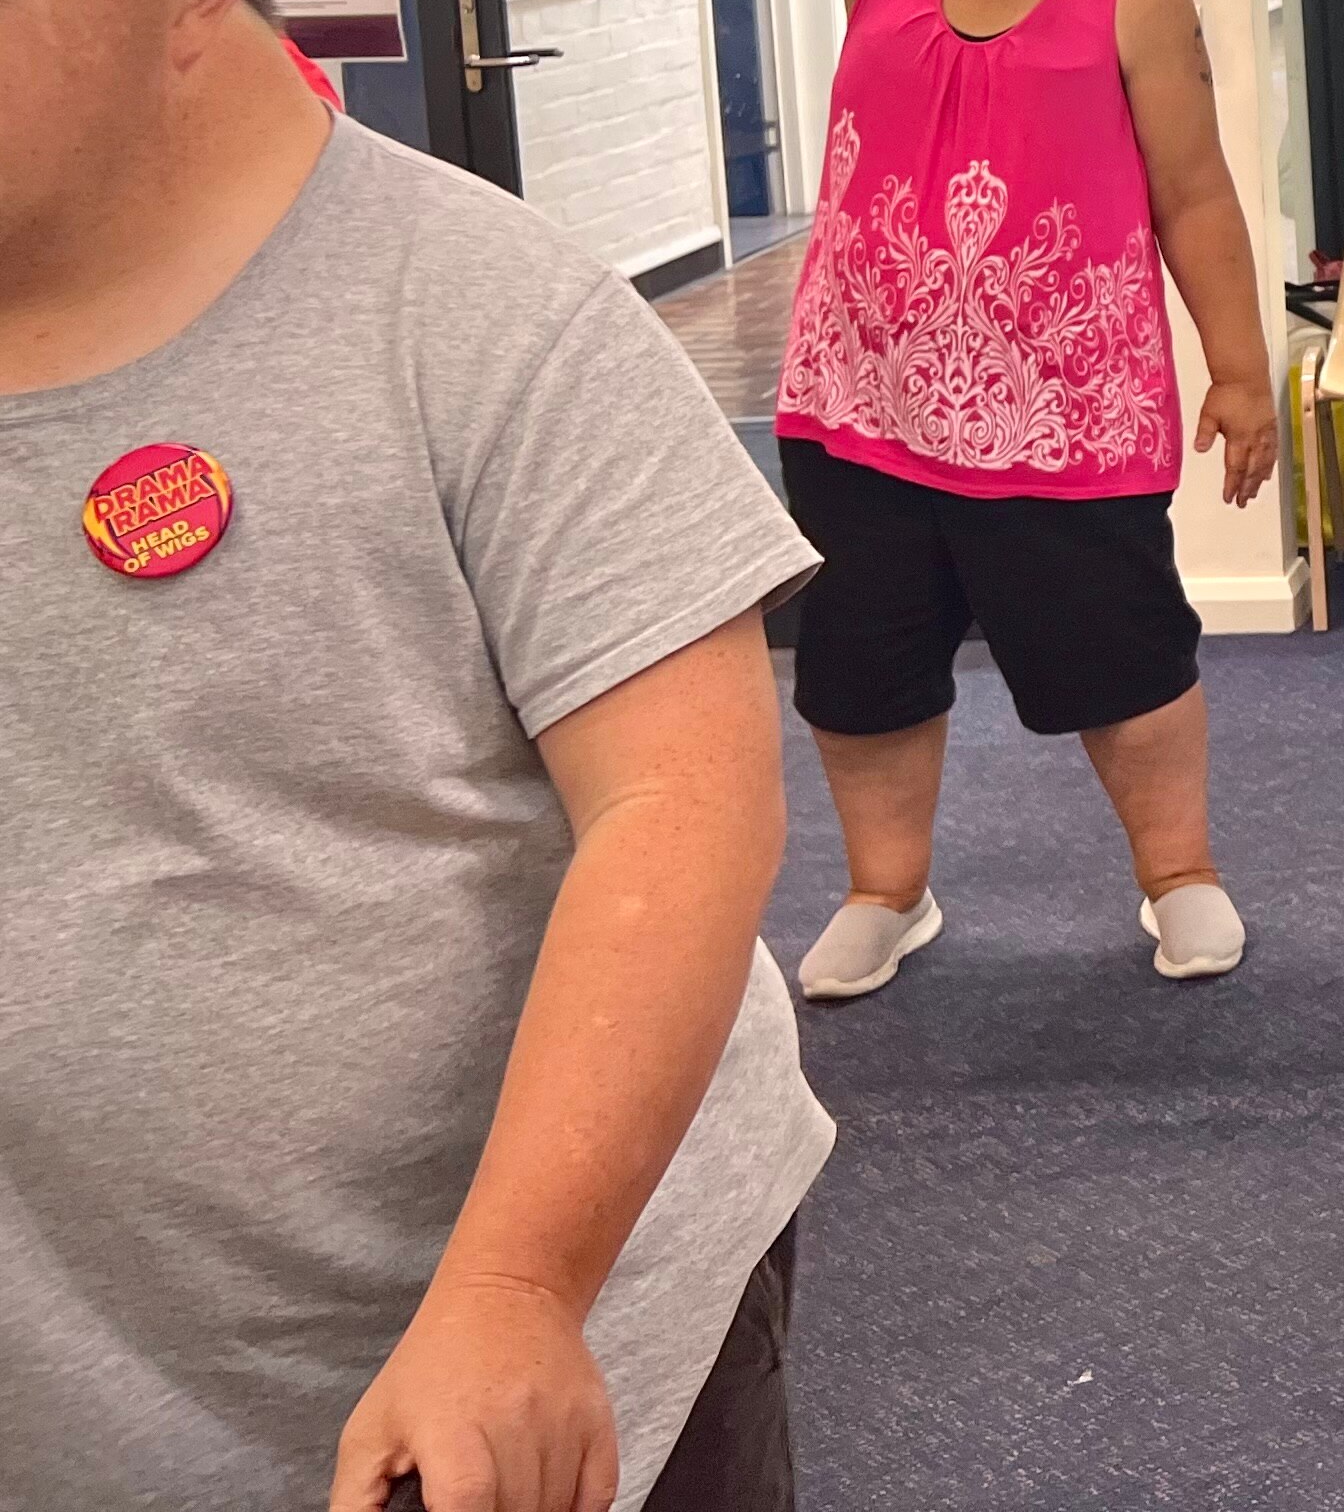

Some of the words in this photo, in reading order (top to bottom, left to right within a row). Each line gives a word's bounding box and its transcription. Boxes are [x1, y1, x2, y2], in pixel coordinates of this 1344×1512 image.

[93, 453, 213, 524] DRAMA
[110, 475, 217, 537] RAMA
[123, 551, 151, 573] OF
[154, 525, 210, 559] WIGS
[131, 519, 189, 555] HEAD
